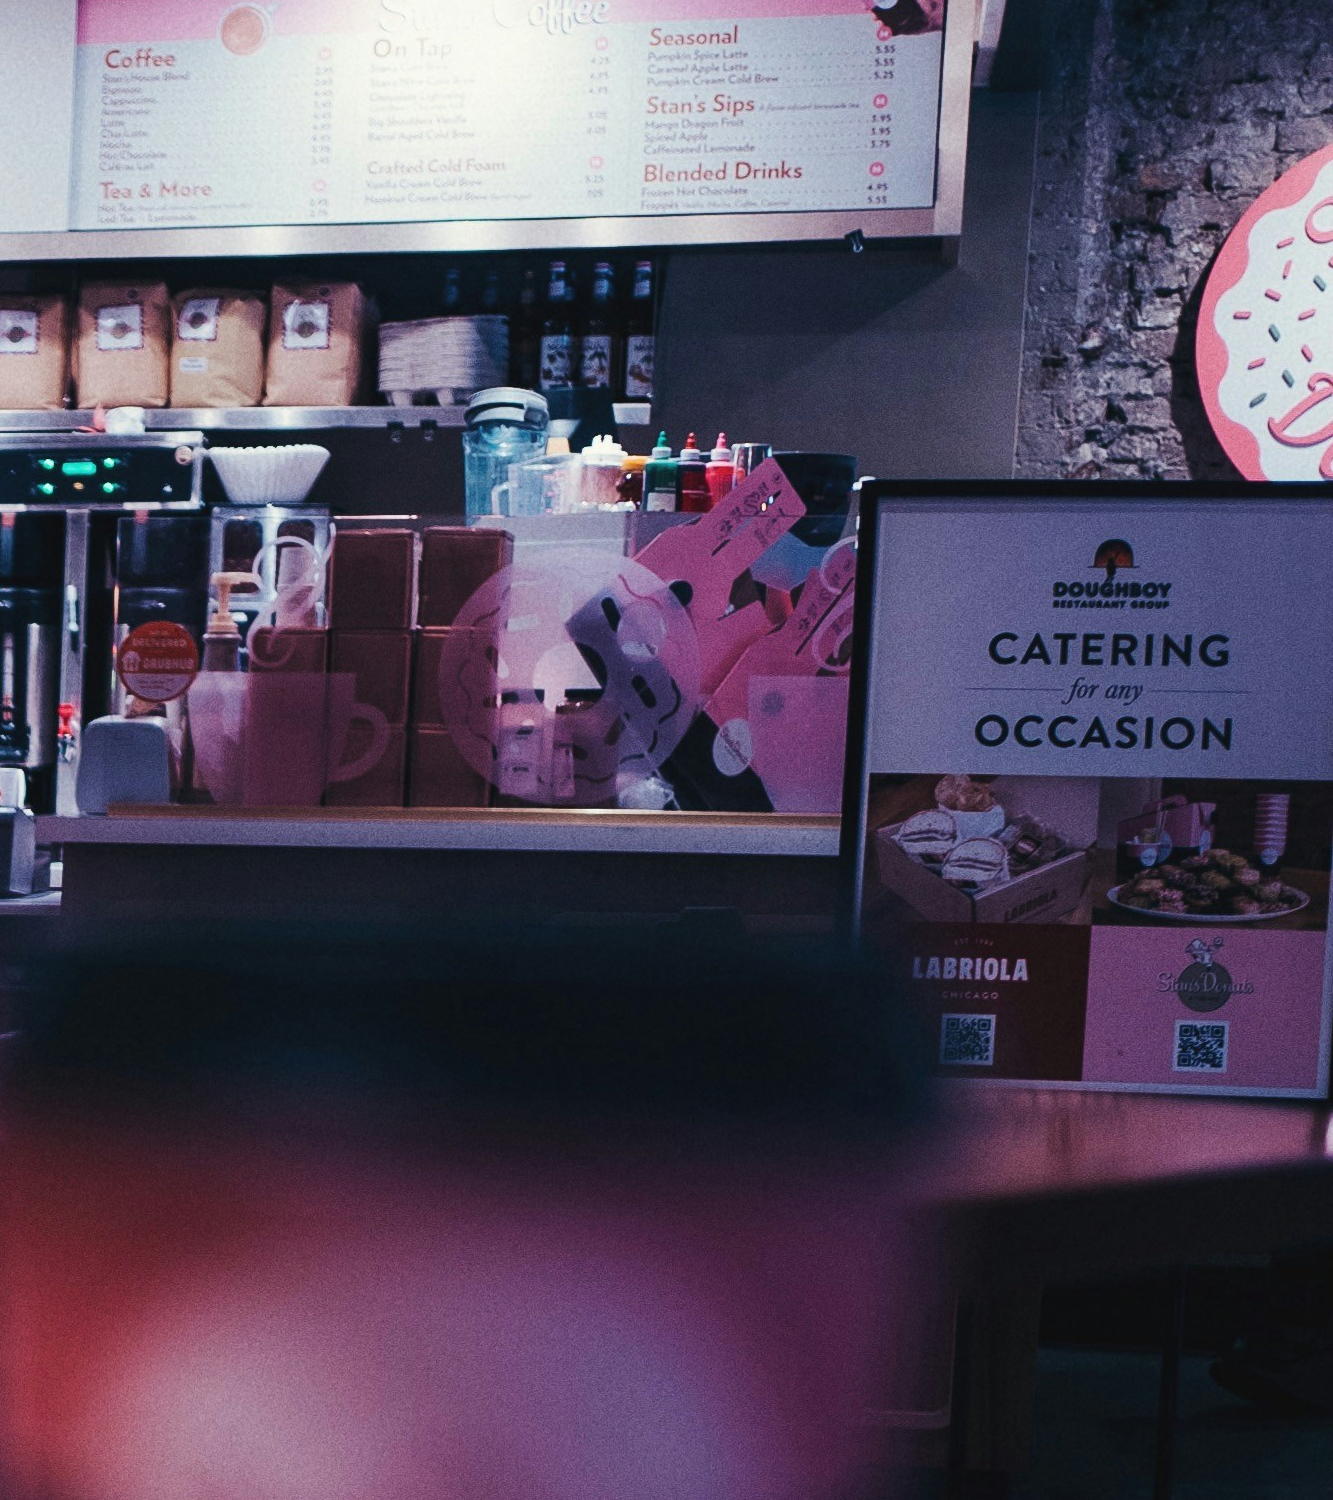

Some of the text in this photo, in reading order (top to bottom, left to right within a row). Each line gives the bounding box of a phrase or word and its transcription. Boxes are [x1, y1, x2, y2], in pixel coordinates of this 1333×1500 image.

[649, 24, 739, 47] Seasonal
[104, 48, 177, 70] Coffee
[372, 36, 453, 60] On Tap
[646, 94, 706, 115] Stan's
[712, 93, 756, 117] Sips
[367, 157, 507, 176] Crafted Cold Foam
[644, 160, 803, 182] Blended Drinks
[99, 179, 213, 200] Tea & More
[1052, 581, 1172, 599] DOUGHBOY
[1052, 599, 1170, 610] RESTAURANT GROUP
[988, 631, 1230, 668] CATERING
[1061, 677, 1145, 706] for any
[974, 713, 1234, 751] OCCASION
[912, 956, 1029, 982] LABRIOLA
[940, 989, 1000, 1000] CHICAGO
